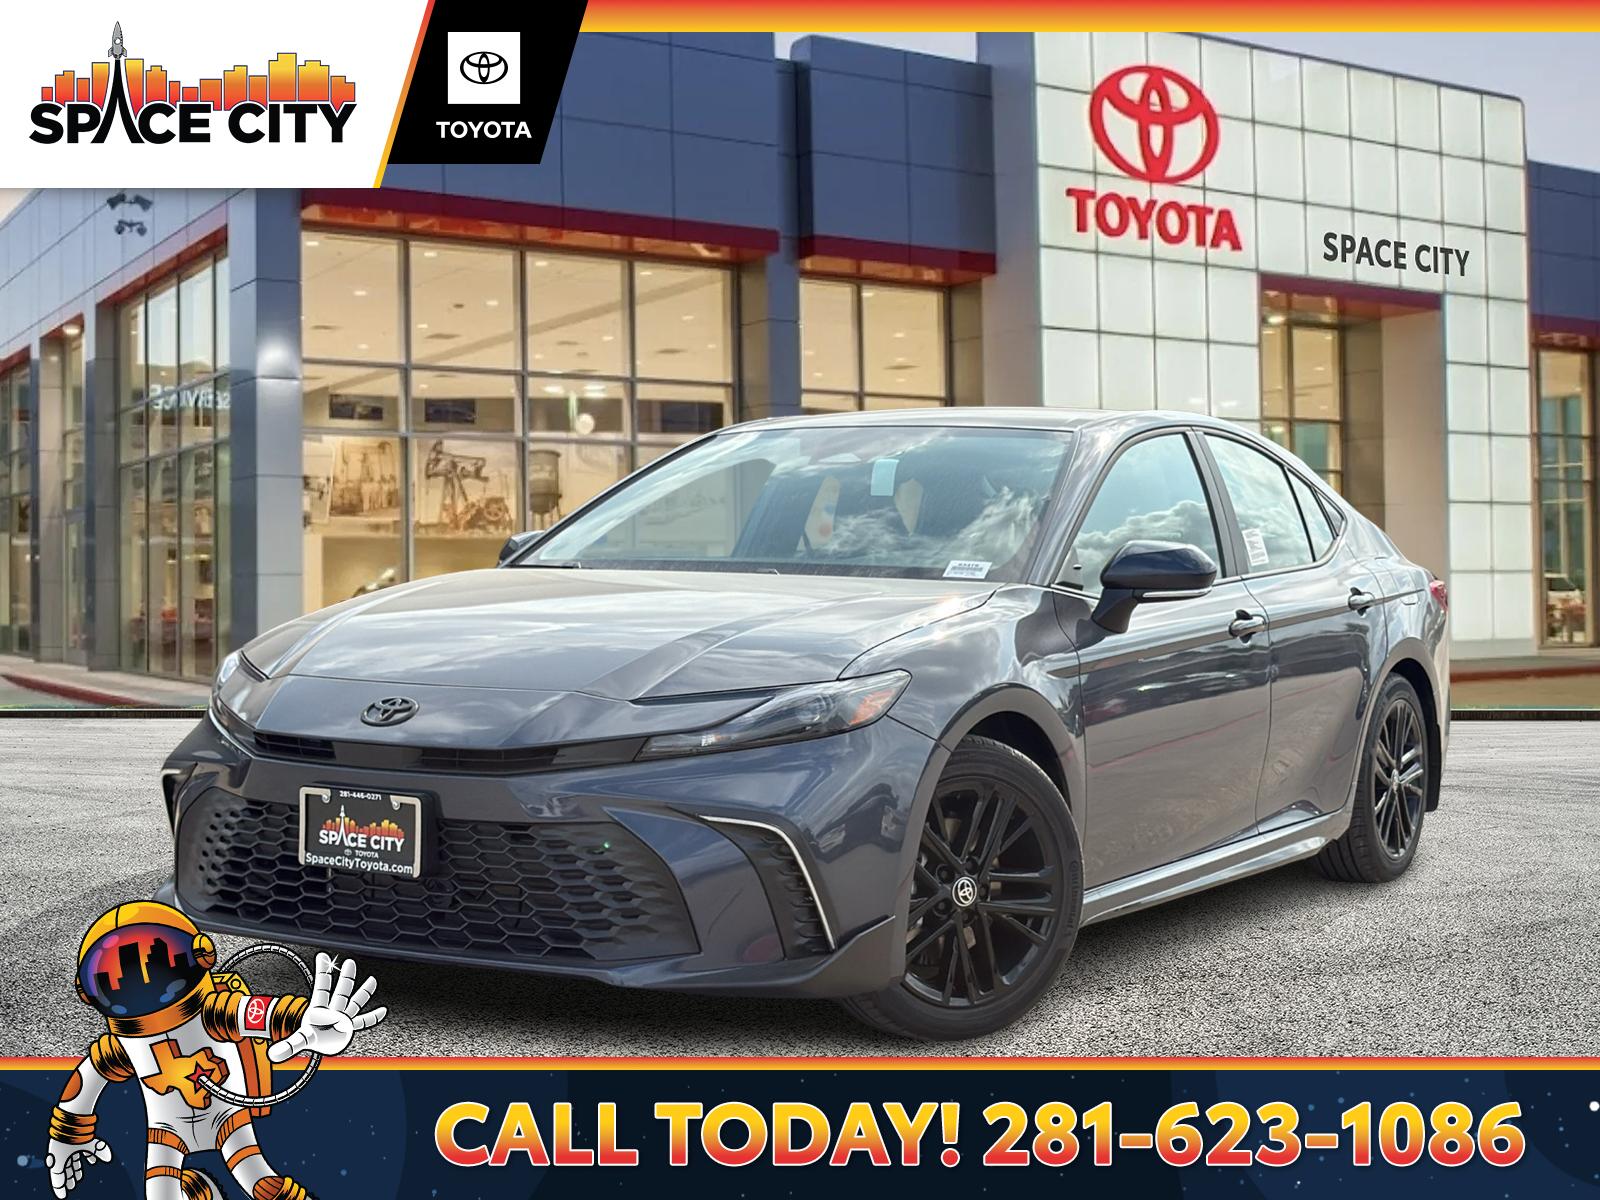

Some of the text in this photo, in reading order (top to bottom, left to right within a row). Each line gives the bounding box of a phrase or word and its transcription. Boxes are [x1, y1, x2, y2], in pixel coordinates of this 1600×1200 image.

[1066, 187, 1242, 251] TOYOTA
[1323, 231, 1471, 277] SPACE CITY
[318, 826, 405, 852] SPACE CITY
[305, 852, 413, 875] SpaceCityToyota.com
[354, 850, 379, 859] TOYOTA
